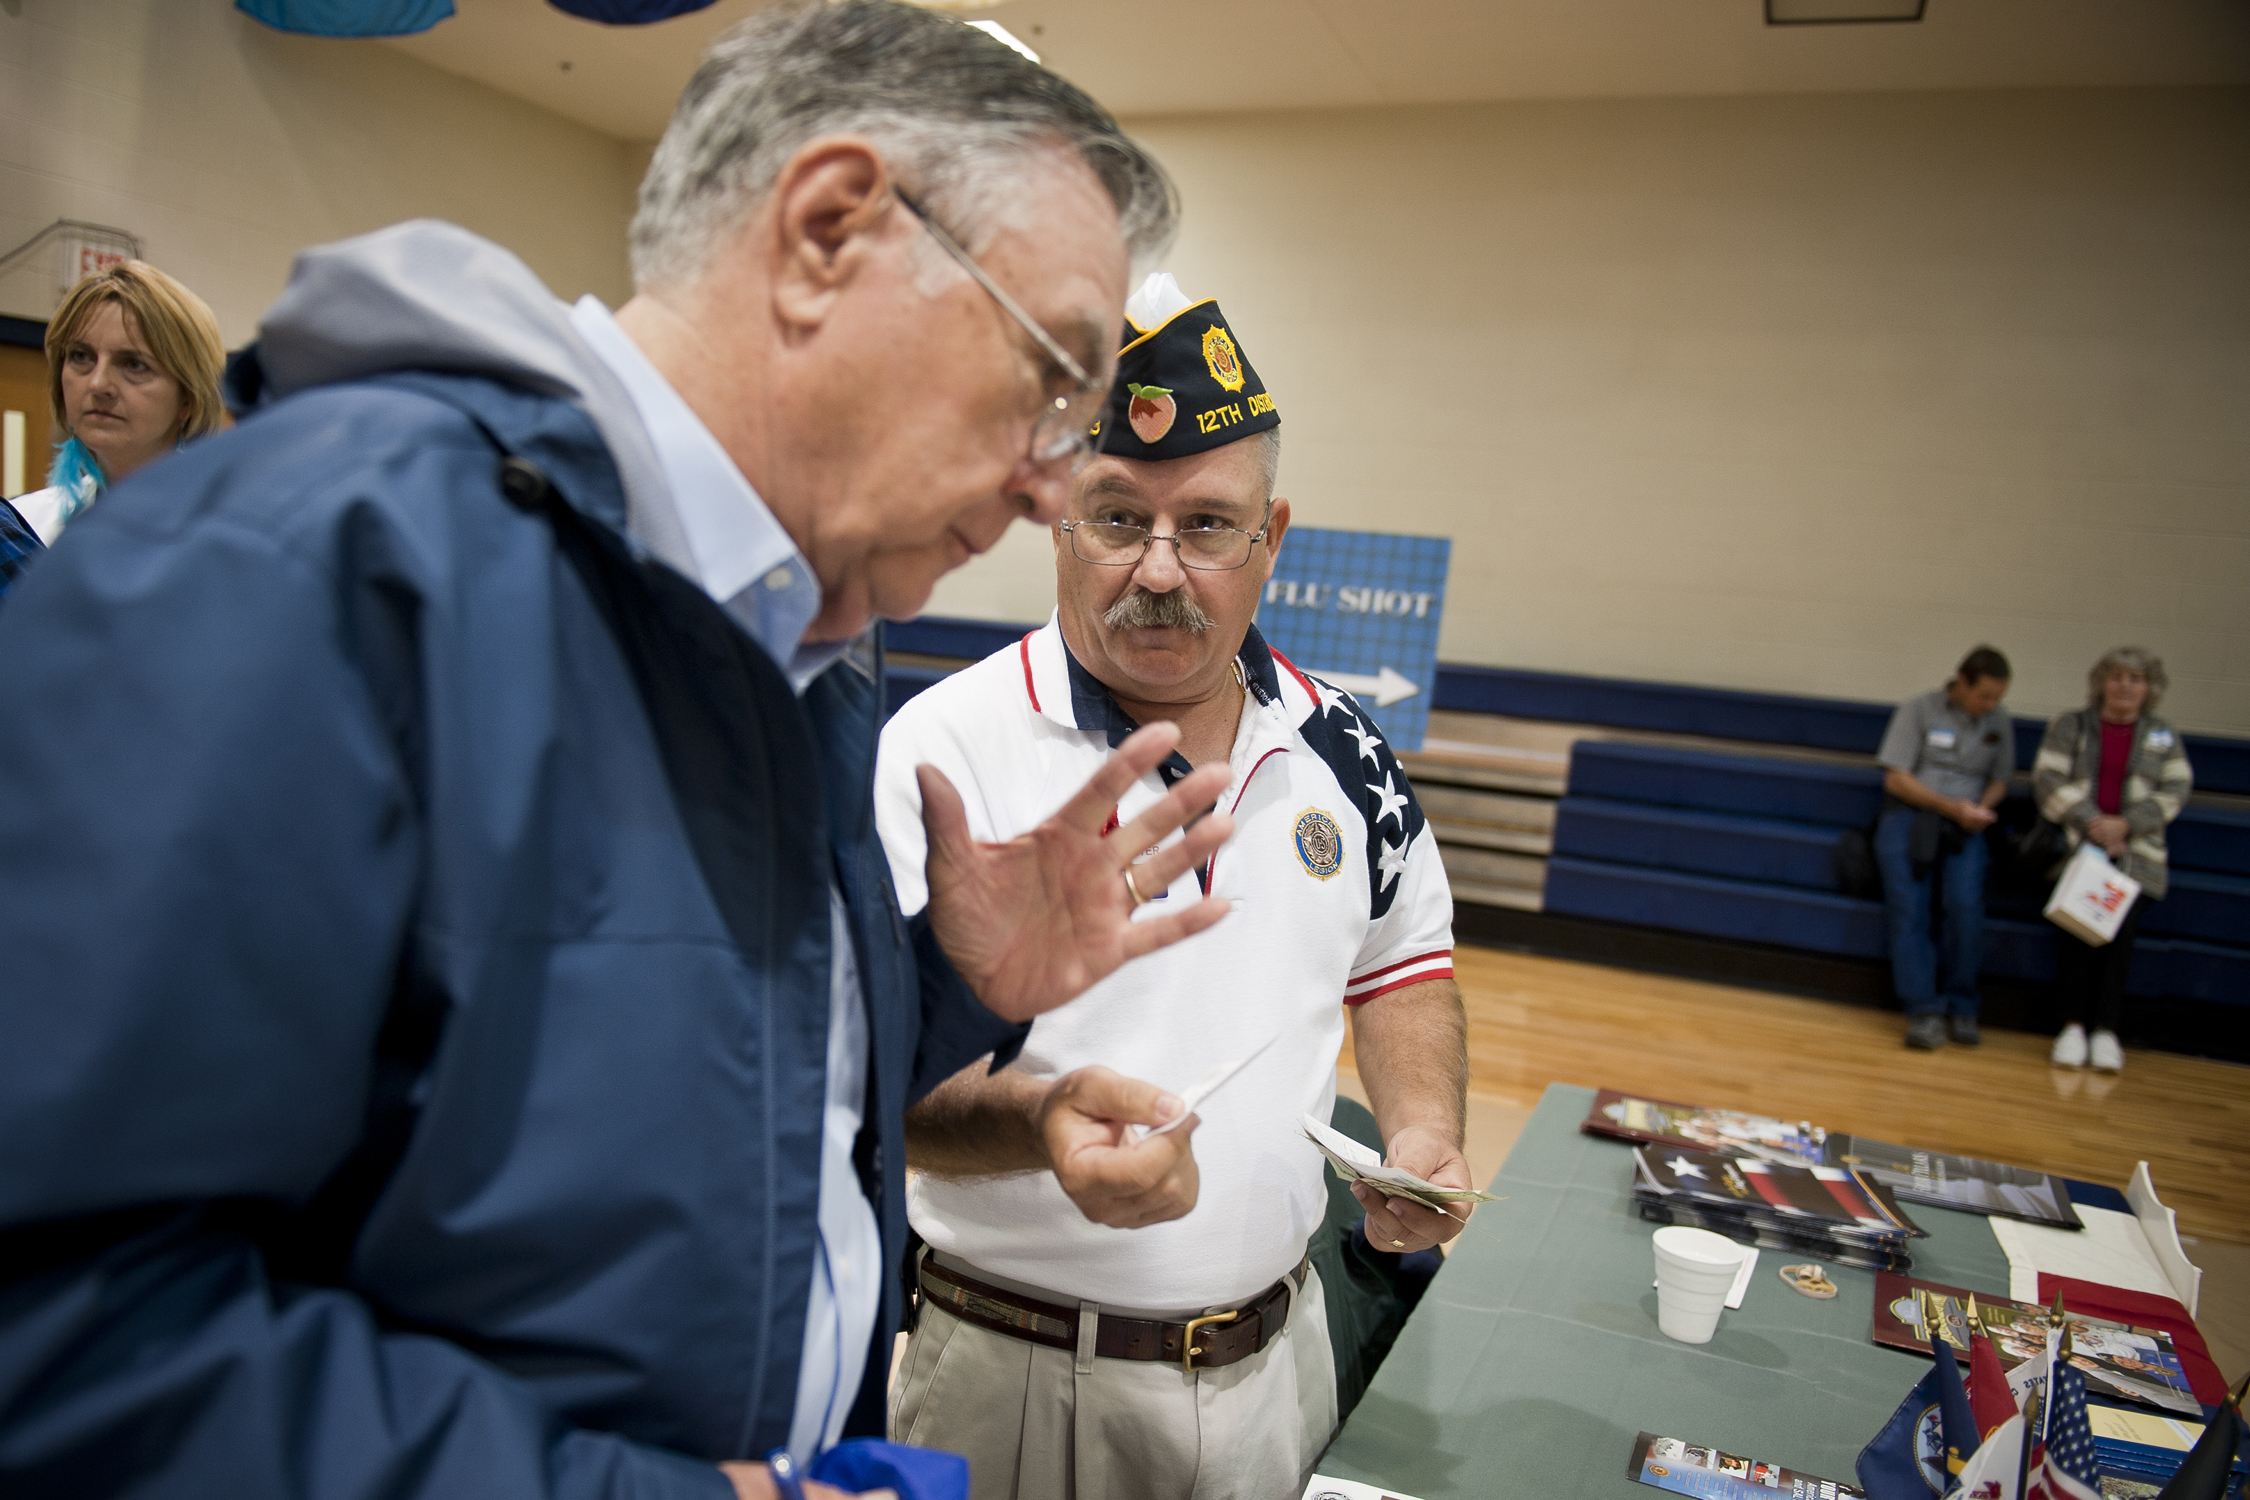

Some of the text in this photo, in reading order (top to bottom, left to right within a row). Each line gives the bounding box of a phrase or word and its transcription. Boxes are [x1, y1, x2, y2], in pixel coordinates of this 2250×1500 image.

[1196, 402, 1244, 433] 12TH
[1265, 579, 1435, 619] FLU SHOT
[1296, 813, 1340, 837] AMERICAN
[1309, 861, 1338, 874] LEGION
